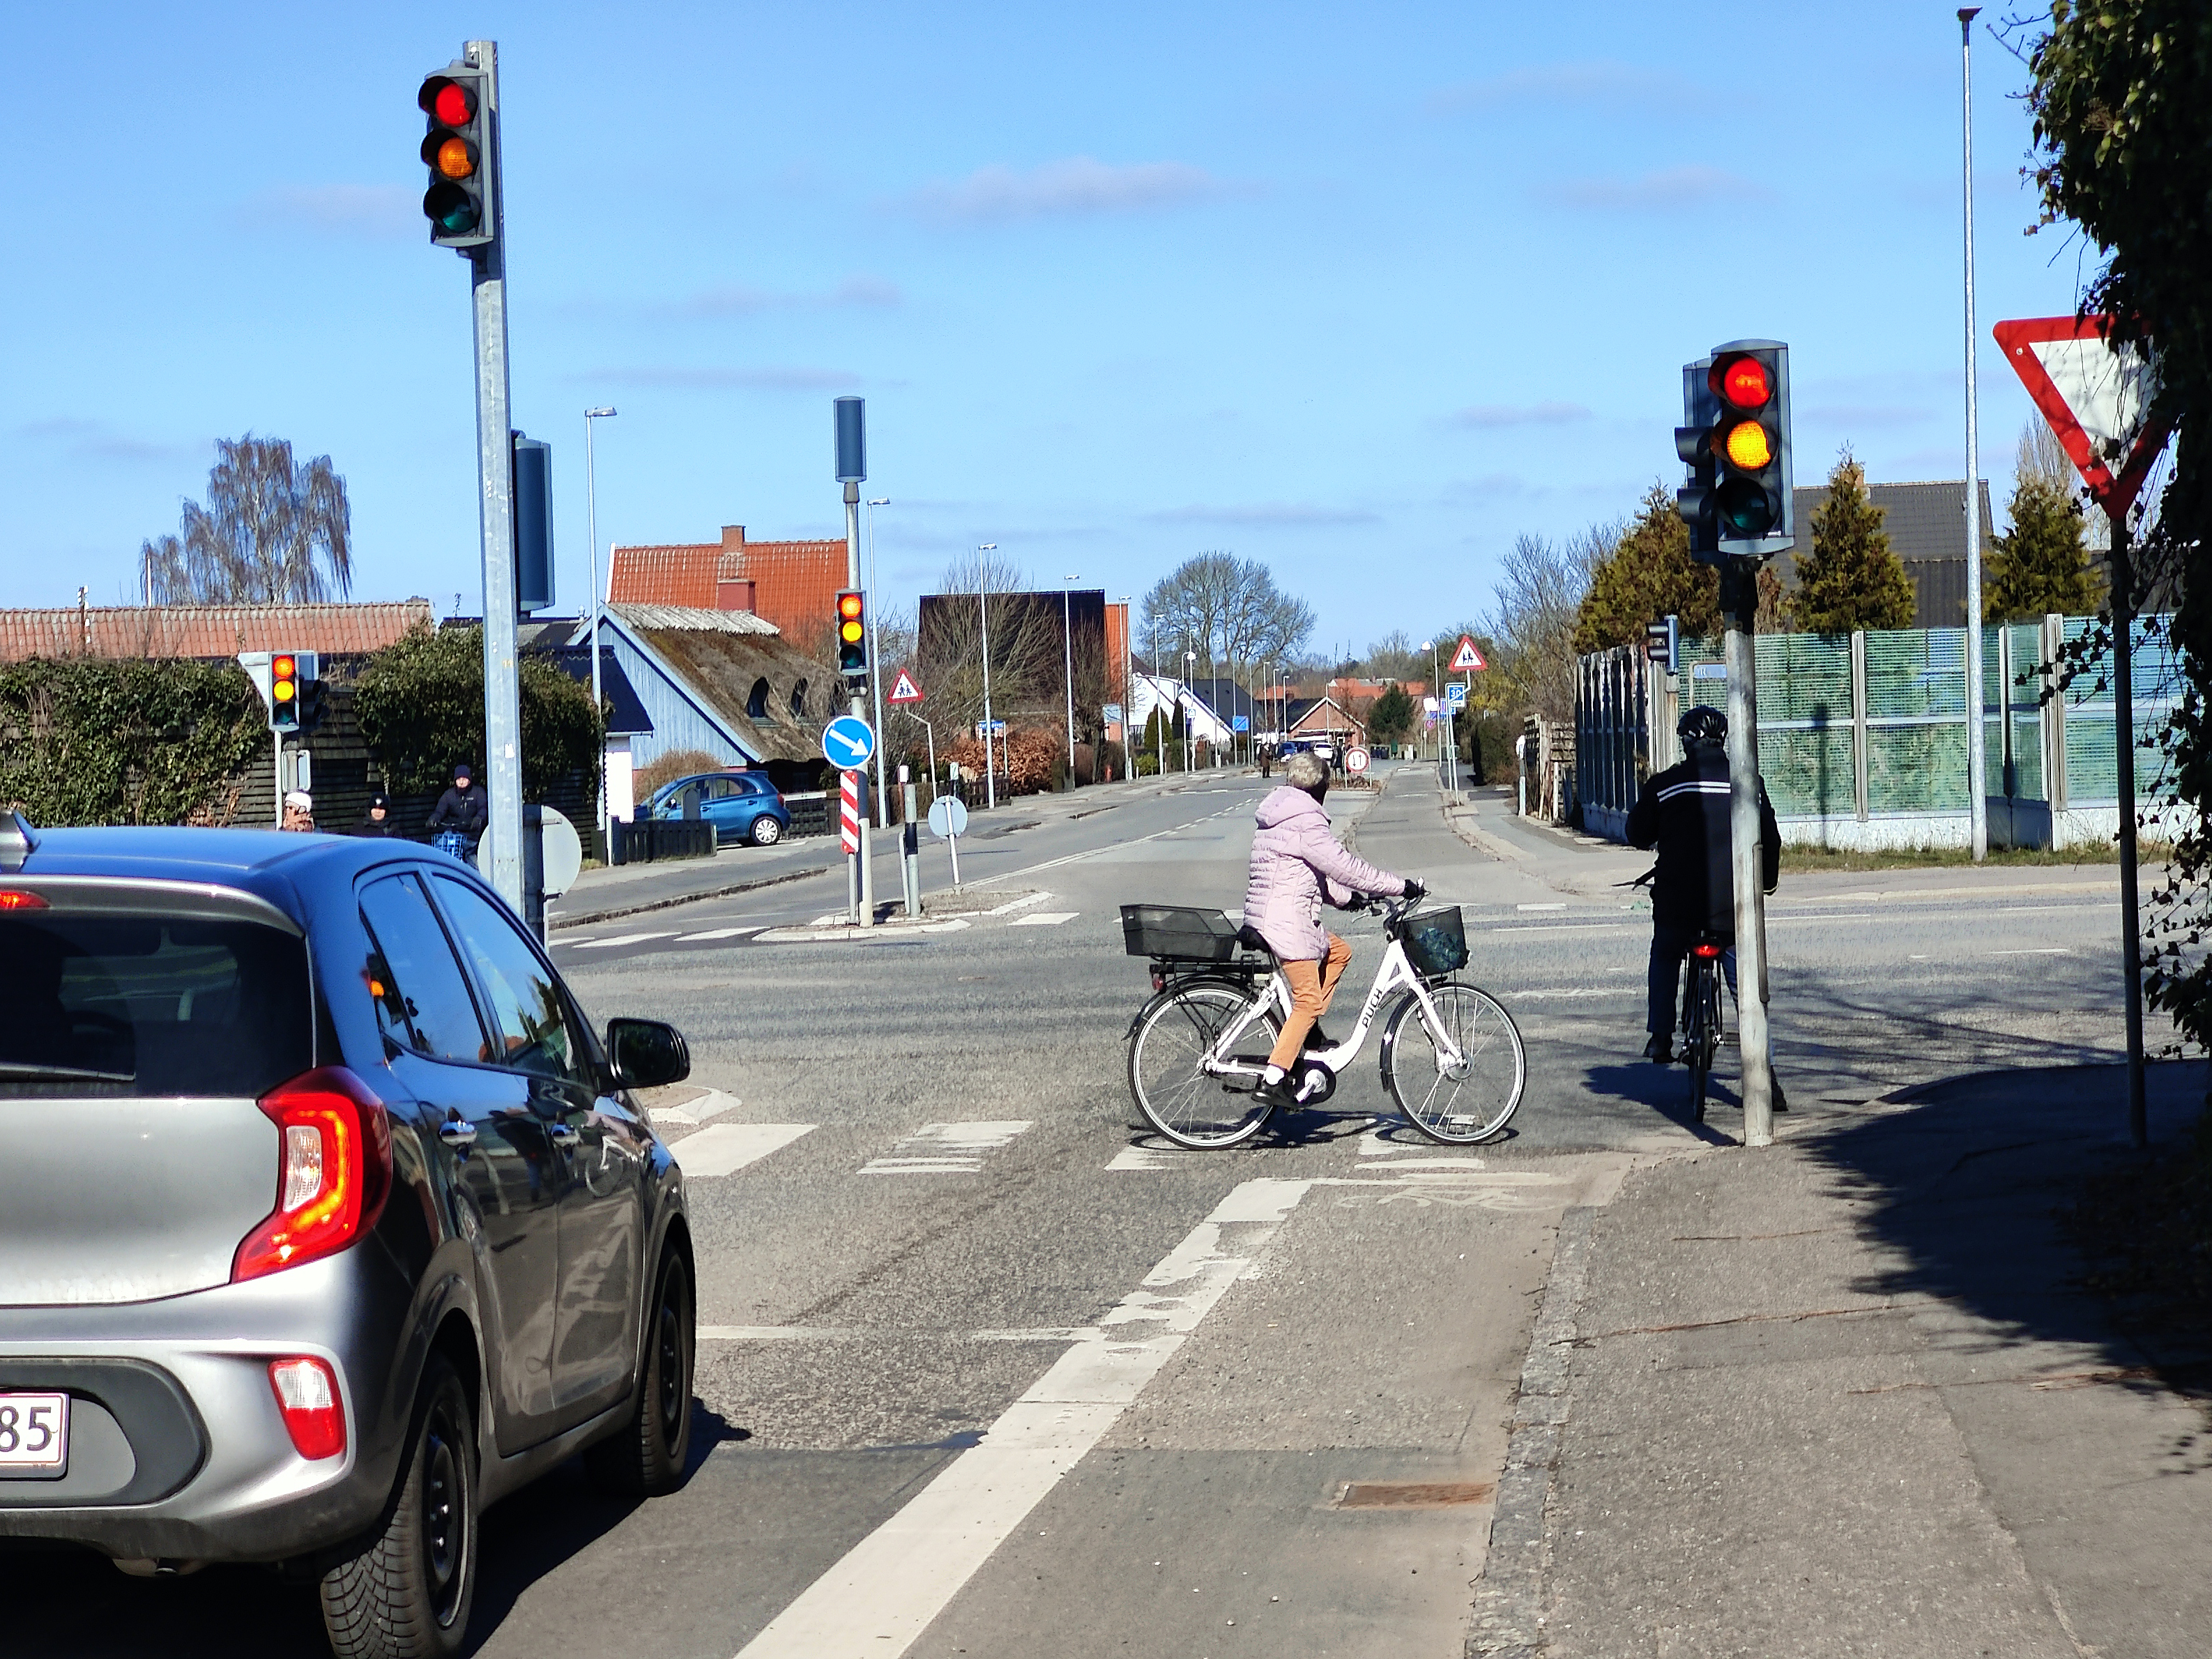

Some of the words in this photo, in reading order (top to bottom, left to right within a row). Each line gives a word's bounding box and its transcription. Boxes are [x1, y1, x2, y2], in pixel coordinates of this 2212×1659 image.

[1450, 689, 1461, 698] 30
[1361, 988, 1382, 1029] PUCH
[0, 1406, 52, 1452] 85
